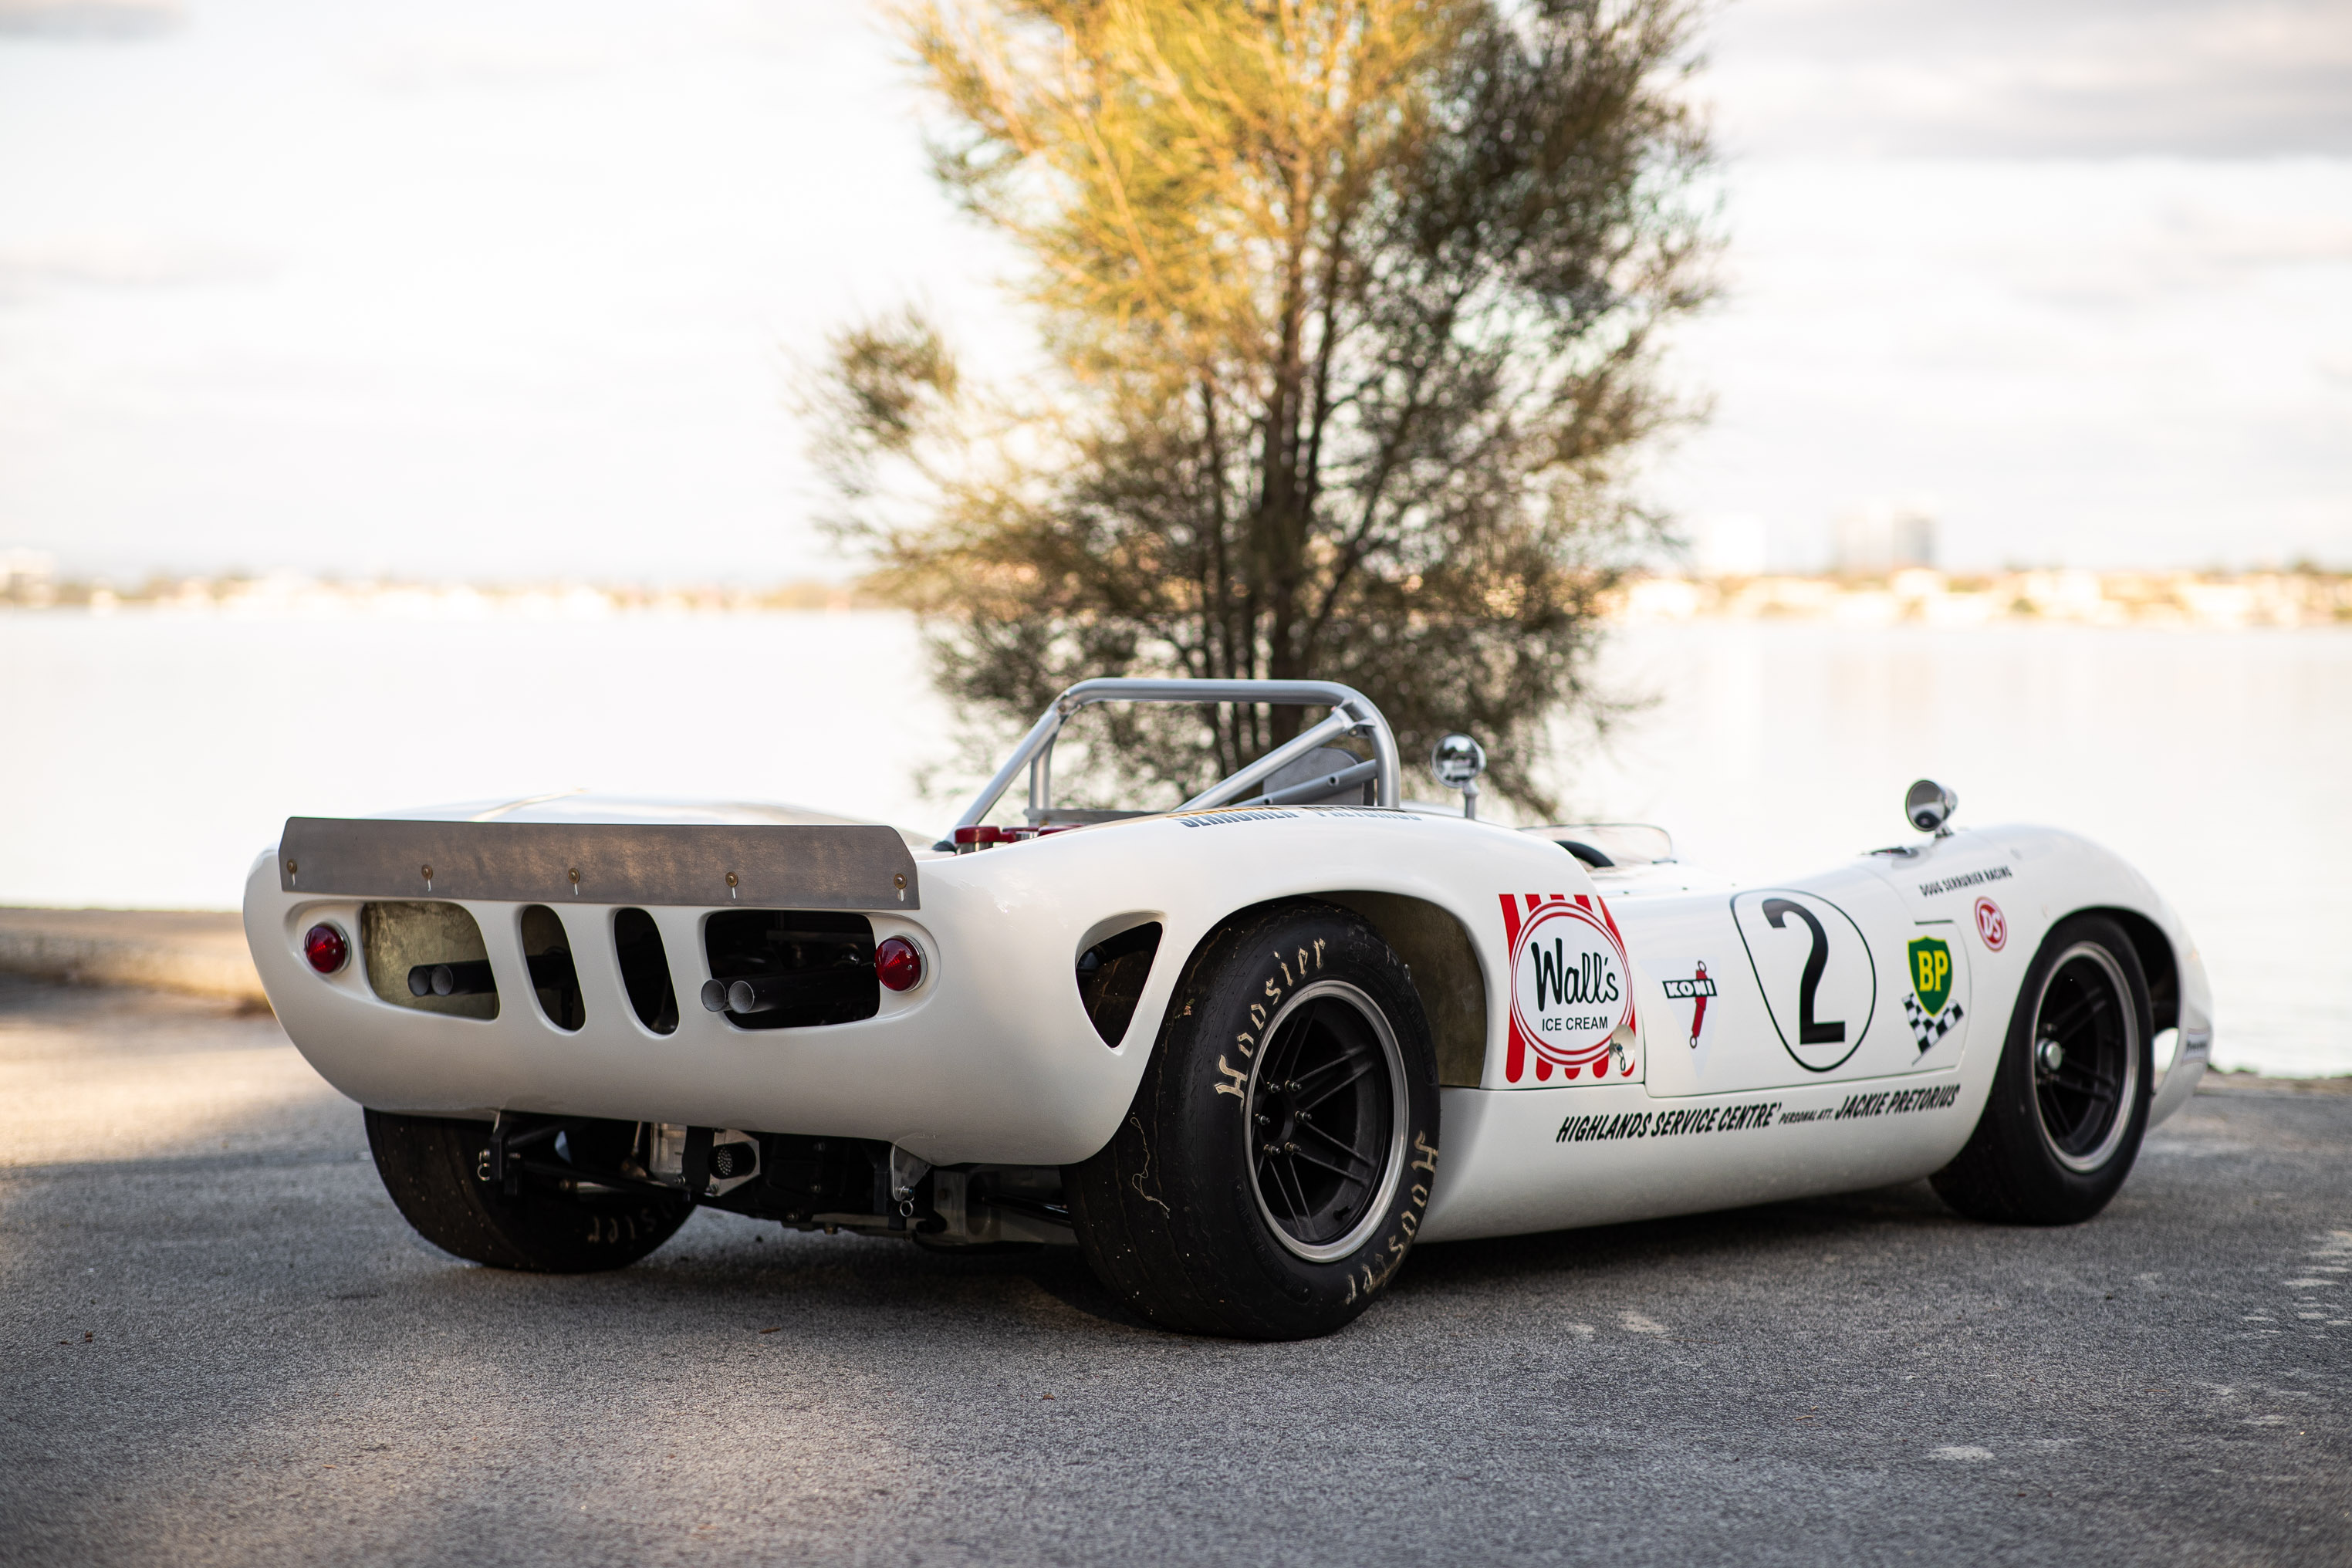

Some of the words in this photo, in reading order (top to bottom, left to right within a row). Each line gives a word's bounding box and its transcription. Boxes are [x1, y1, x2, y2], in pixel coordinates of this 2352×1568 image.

[1919, 882, 1944, 897] DOUG
[1983, 865, 2012, 881] RACING
[1979, 908, 2002, 941] DS
[1530, 938, 1619, 1012] Wall's
[1665, 979, 1715, 997] KONI
[1762, 897, 1845, 1045] 2
[1917, 950, 1949, 992] BP
[1215, 938, 1326, 1109] Hoosier
[1541, 1017, 1563, 1032] ICE
[1565, 1016, 1608, 1030] CREAM
[1556, 1112, 1653, 1143] HIGHLANDS
[1651, 1107, 1720, 1137] SERVICE
[1778, 1110, 1818, 1125] PERSONAL
[1834, 1091, 1891, 1121] JACKIE
[1885, 1083, 1961, 1115] PRETORIUS
